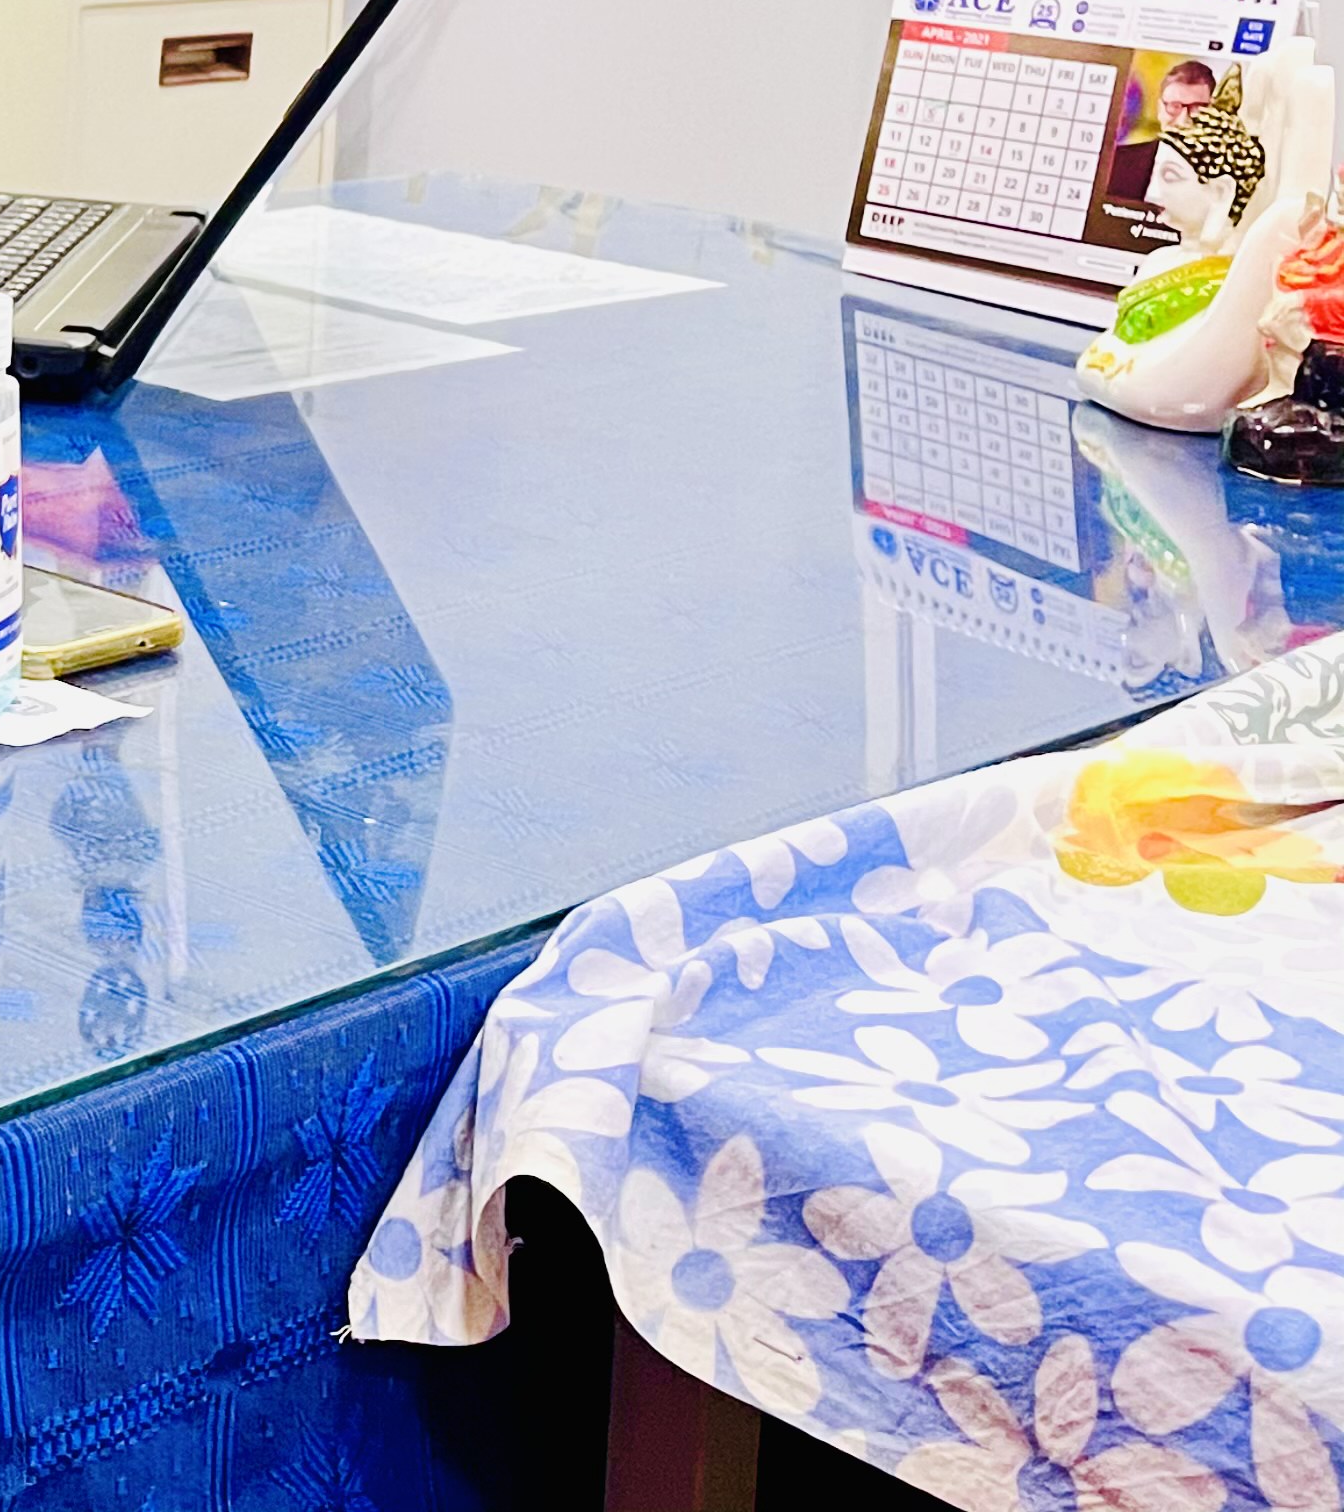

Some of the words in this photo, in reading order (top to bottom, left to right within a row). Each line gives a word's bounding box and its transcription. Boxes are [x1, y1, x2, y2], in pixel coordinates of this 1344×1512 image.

[921, 25, 954, 41] APRIL
[962, 29, 990, 46] 2021
[902, 48, 923, 61] SUN
[930, 51, 955, 64] MON
[964, 57, 983, 70] TUE
[992, 61, 1016, 74] WED
[1024, 65, 1046, 78] THU
[1057, 68, 1075, 81] FRI
[1088, 73, 1108, 85] SAT
[890, 130, 902, 141] 11
[919, 135, 932, 147] 12
[949, 140, 962, 152] 13
[980, 144, 993, 156] 14
[1012, 149, 1024, 161] 15
[1042, 155, 1055, 167] 16
[1074, 160, 1088, 172] 17
[1080, 131, 1094, 143] 10
[884, 157, 896, 168] 18
[914, 162, 926, 173] 19
[941, 167, 956, 179] 20
[973, 172, 987, 184] 21
[1004, 177, 1018, 189] 22
[1035, 182, 1049, 195] 23
[1067, 187, 1081, 200] 24
[872, 212, 905, 226] DEEP
[877, 183, 890, 196] 25
[906, 189, 920, 201] 26
[935, 194, 950, 206] 27
[966, 200, 981, 212] 28
[997, 205, 1012, 218] 29
[1029, 210, 1044, 223] 30
